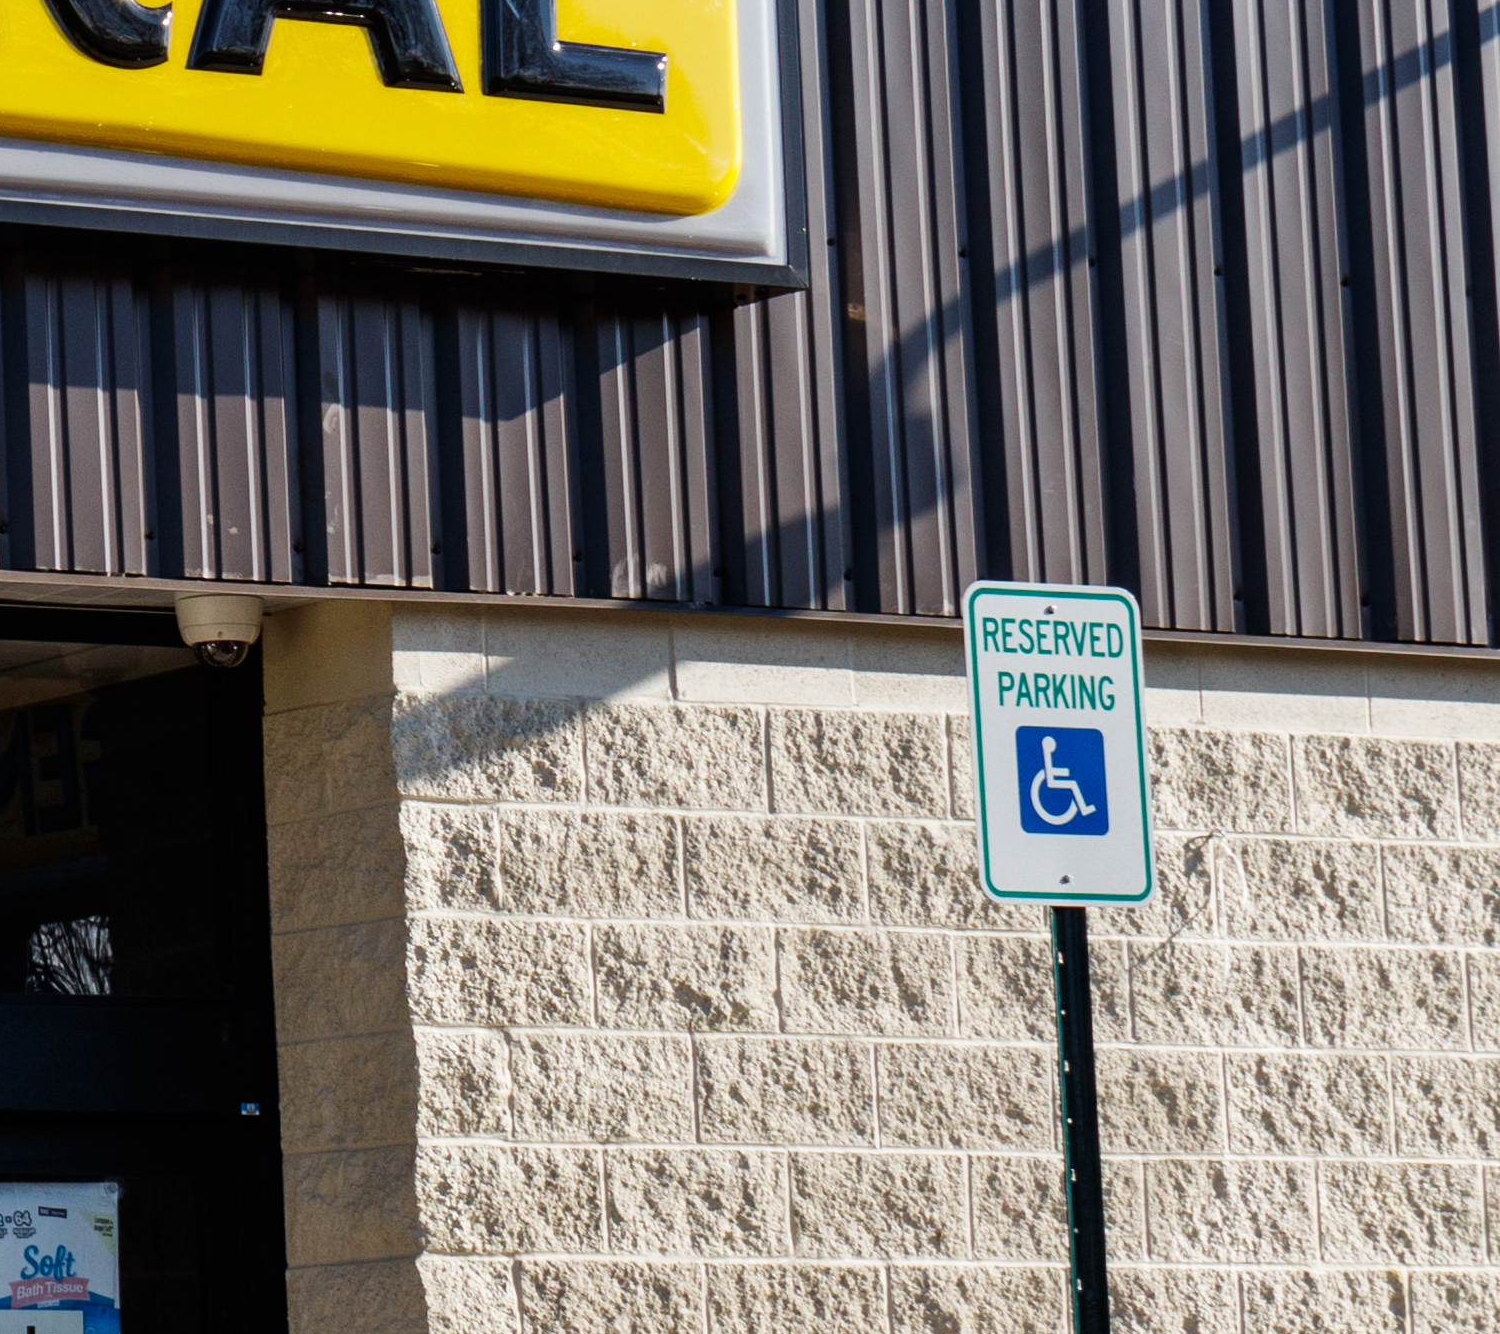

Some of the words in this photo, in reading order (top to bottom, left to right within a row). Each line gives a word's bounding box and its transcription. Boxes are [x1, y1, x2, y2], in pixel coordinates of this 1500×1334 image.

[982, 617, 1124, 658] RESERVED
[998, 671, 1115, 711] PARKING
[20, 1244, 76, 1282] Soft
[17, 1285, 44, 1300] Bath
[45, 1281, 84, 1294] Tissue
